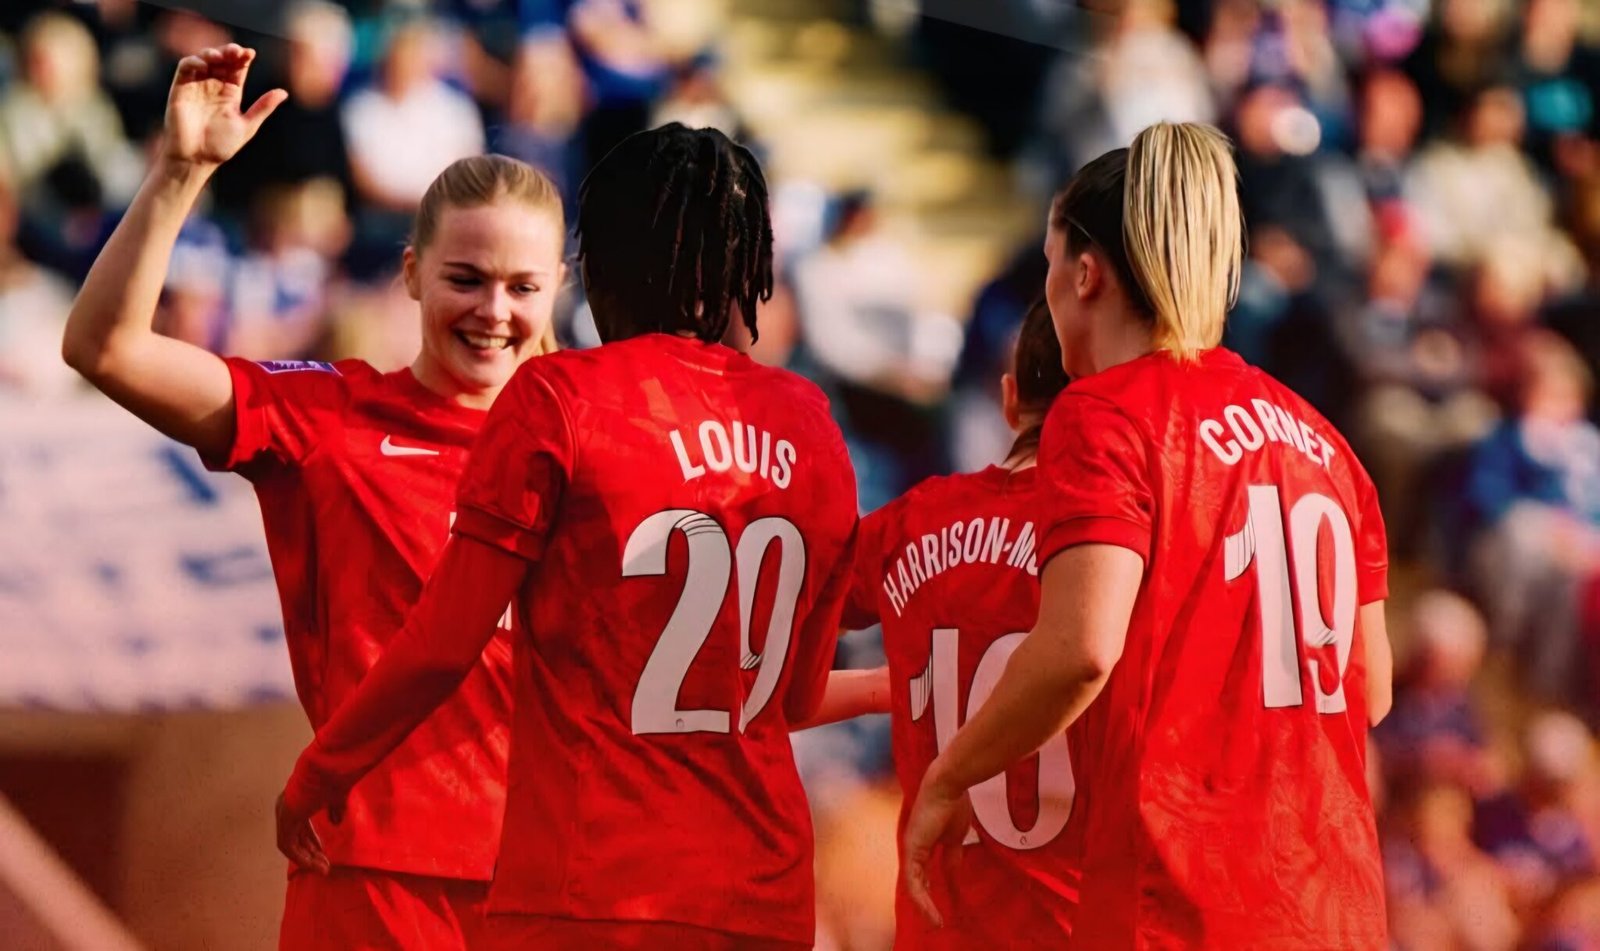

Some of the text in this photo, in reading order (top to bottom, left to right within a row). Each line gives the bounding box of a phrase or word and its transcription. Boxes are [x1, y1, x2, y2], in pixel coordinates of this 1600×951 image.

[669, 420, 797, 489] LOUIS
[1200, 398, 1335, 470] CORNET
[622, 509, 805, 735] 29
[1225, 484, 1358, 714] 19
